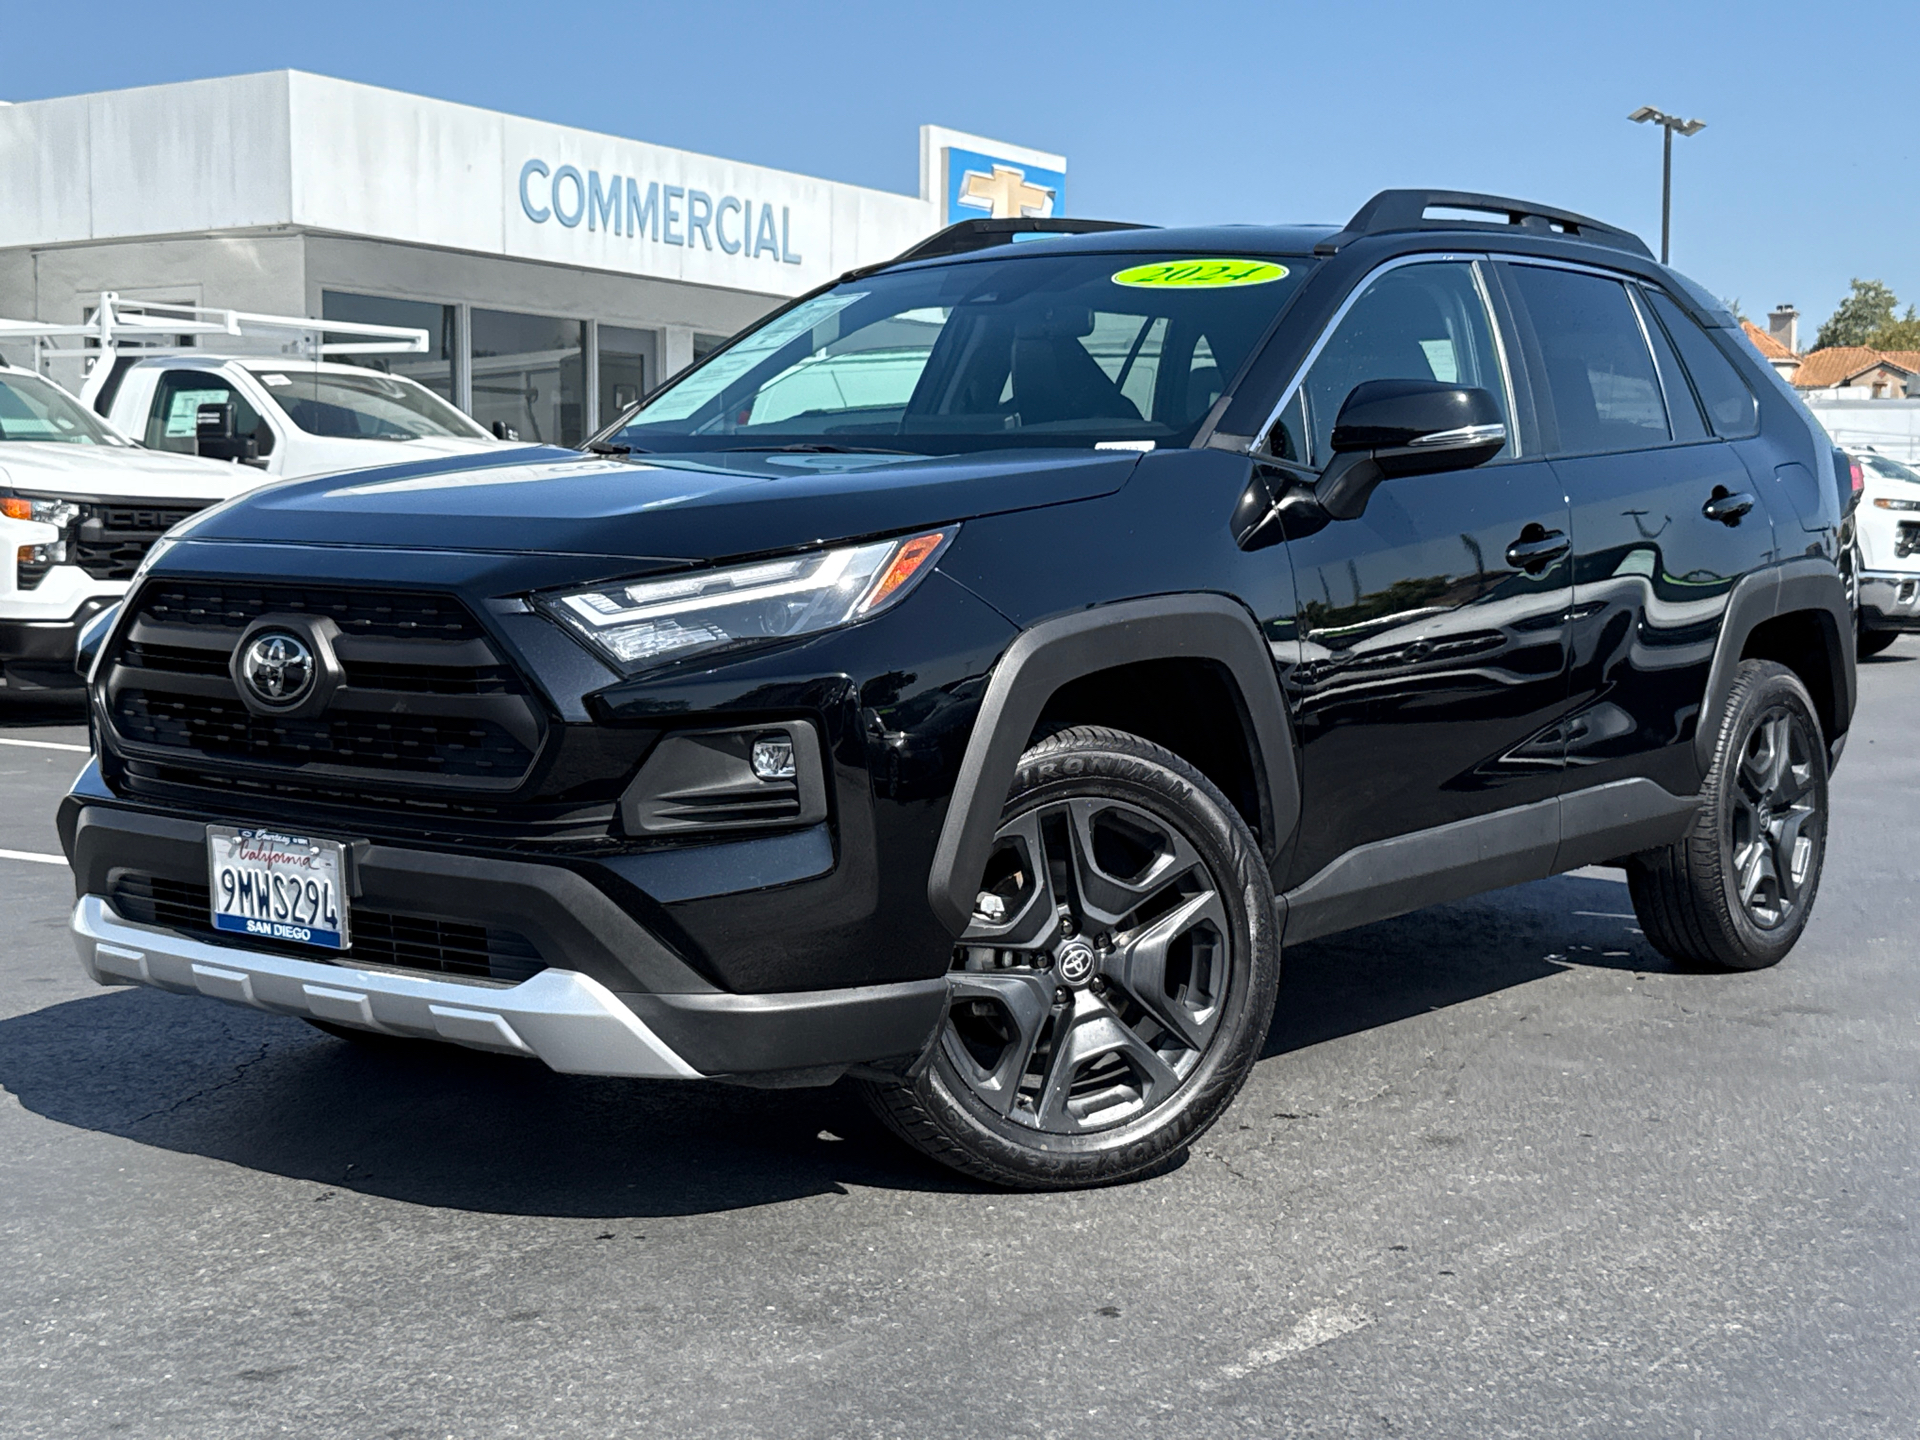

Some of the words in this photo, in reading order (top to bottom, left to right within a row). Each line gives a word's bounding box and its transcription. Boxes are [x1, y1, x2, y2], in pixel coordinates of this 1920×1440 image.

[519, 158, 802, 265] COMMERCIAL
[1134, 265, 1267, 282] 2024
[105, 508, 193, 527] CHE
[1020, 756, 1194, 800] IRONMAN
[239, 839, 320, 870] California
[221, 868, 338, 929] 9MWS294
[246, 920, 272, 936] SAN
[274, 924, 311, 941] DIEGO
